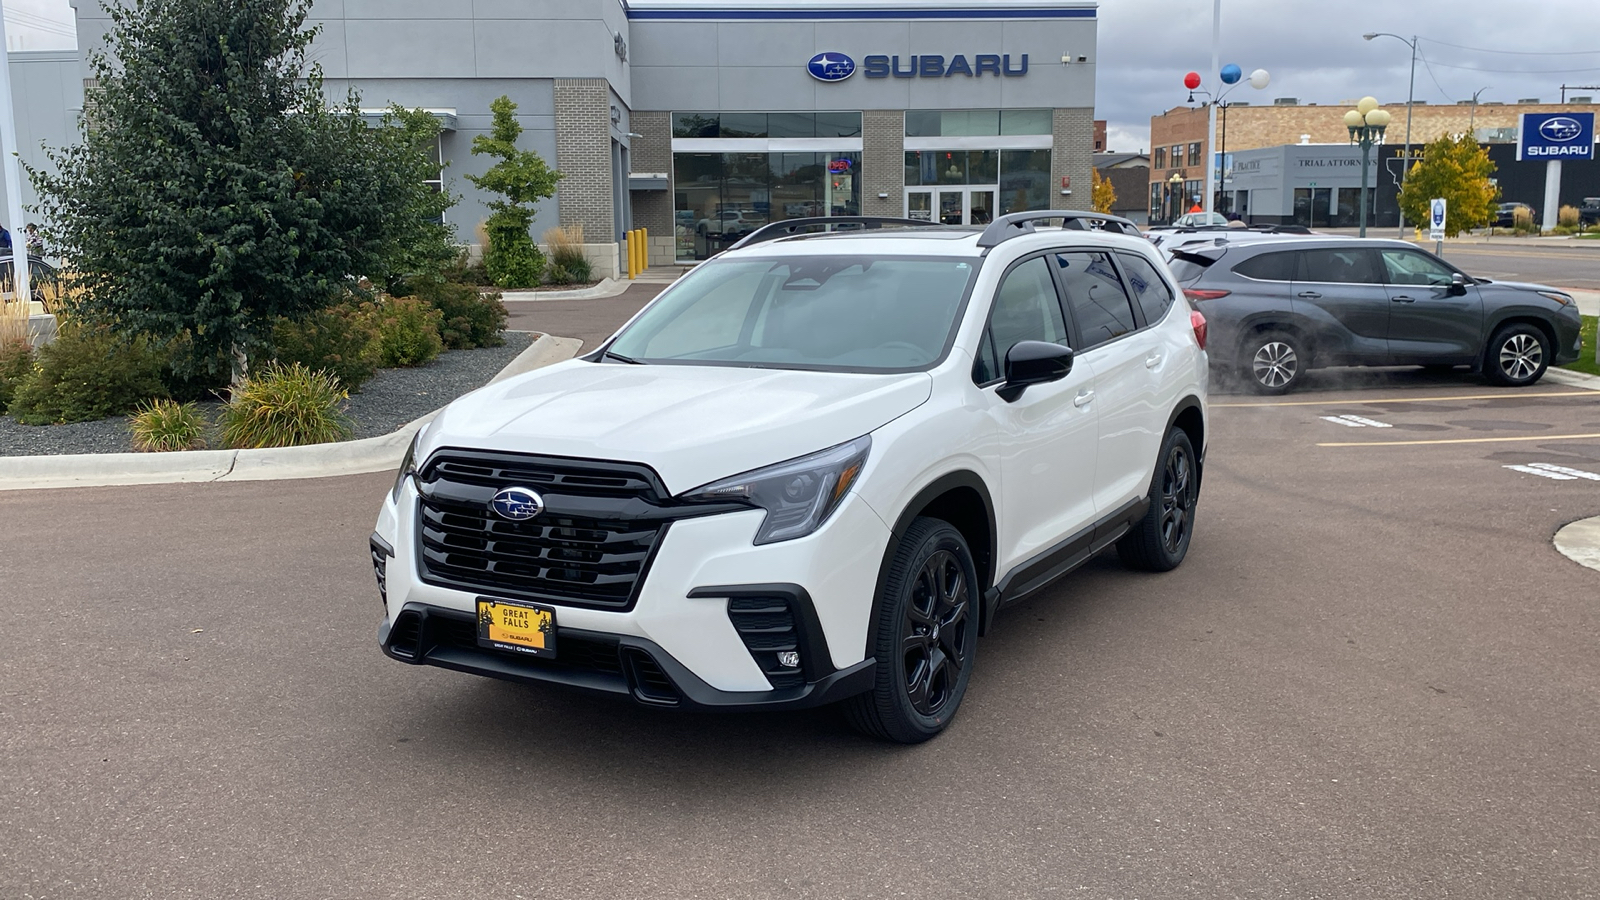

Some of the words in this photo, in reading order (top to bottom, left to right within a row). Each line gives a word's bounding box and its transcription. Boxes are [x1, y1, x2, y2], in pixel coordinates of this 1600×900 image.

[864, 54, 1029, 78] SUBARU
[1527, 145, 1589, 156] SUBARU
[828, 161, 849, 170] OPEN
[1299, 159, 1325, 167] TRIAL
[1327, 159, 1378, 167] ATTORNYS
[503, 608, 529, 619] GREAT
[503, 617, 529, 629] FALLS
[509, 634, 533, 642] SUBARU
